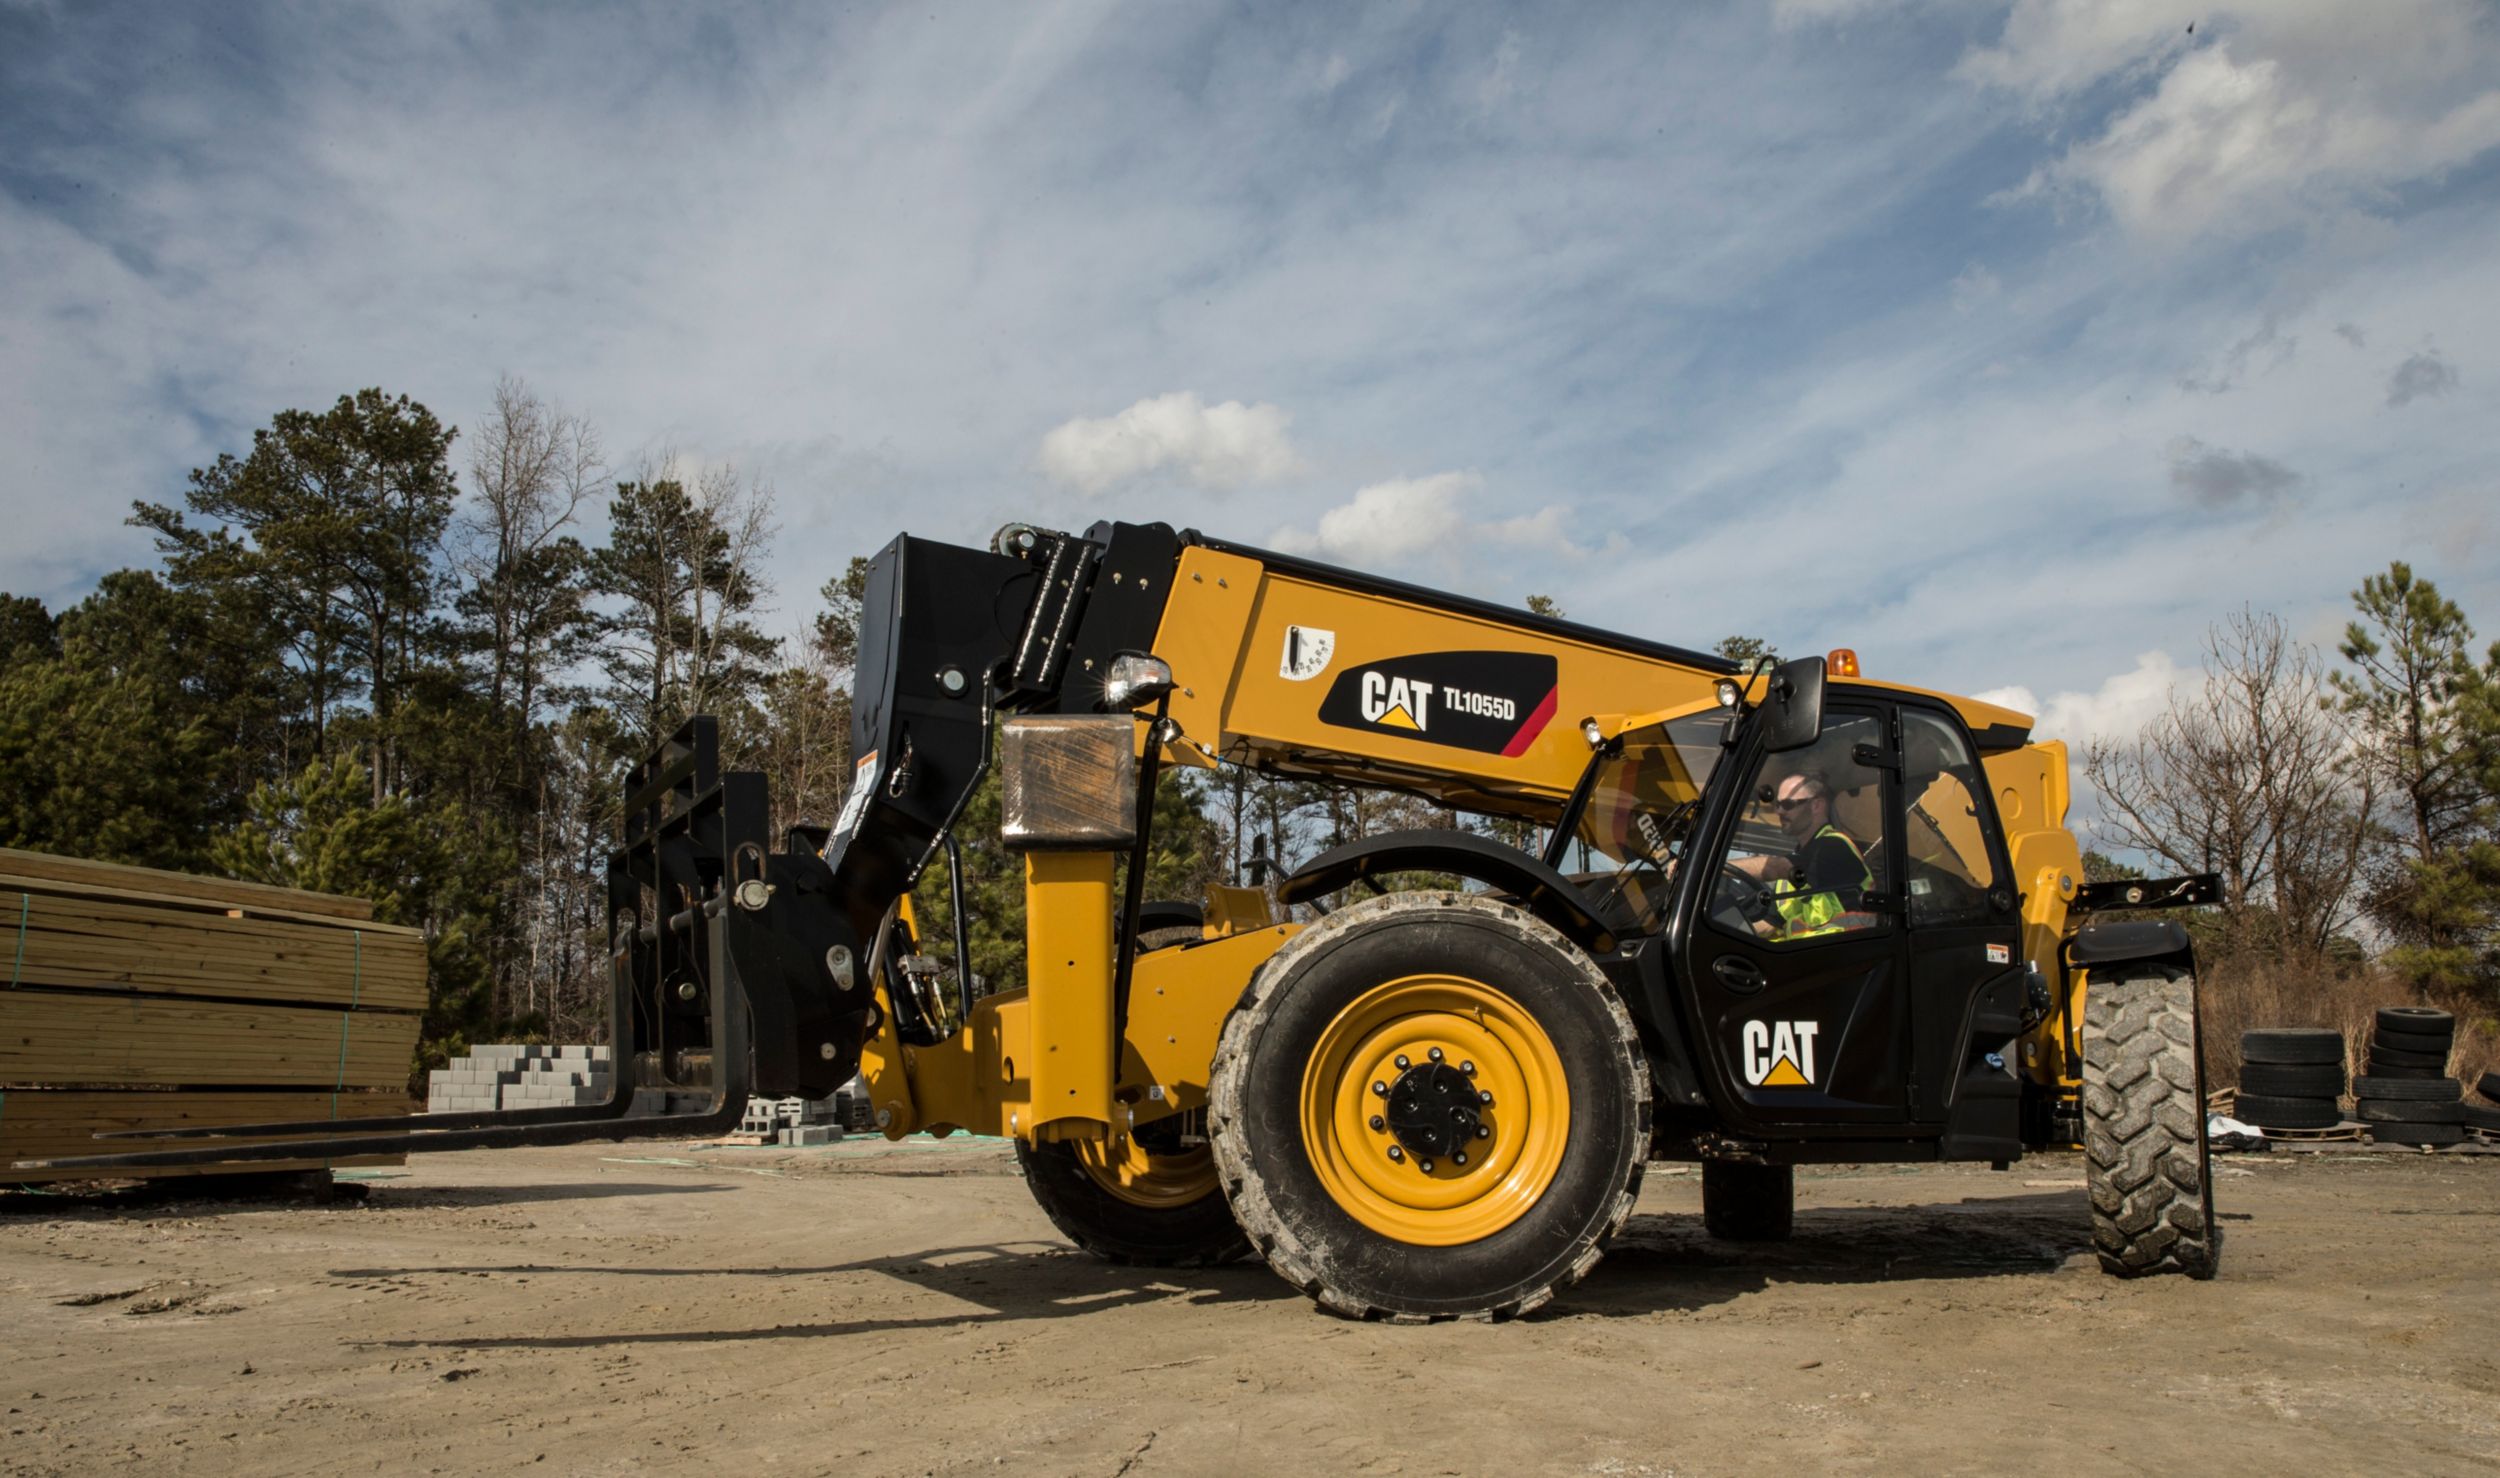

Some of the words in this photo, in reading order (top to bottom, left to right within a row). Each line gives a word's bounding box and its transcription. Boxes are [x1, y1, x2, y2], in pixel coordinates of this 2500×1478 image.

[1361, 671, 1433, 732] CAT
[1443, 686, 1516, 721] TL1055D
[1742, 1019, 1819, 1086] CAT
